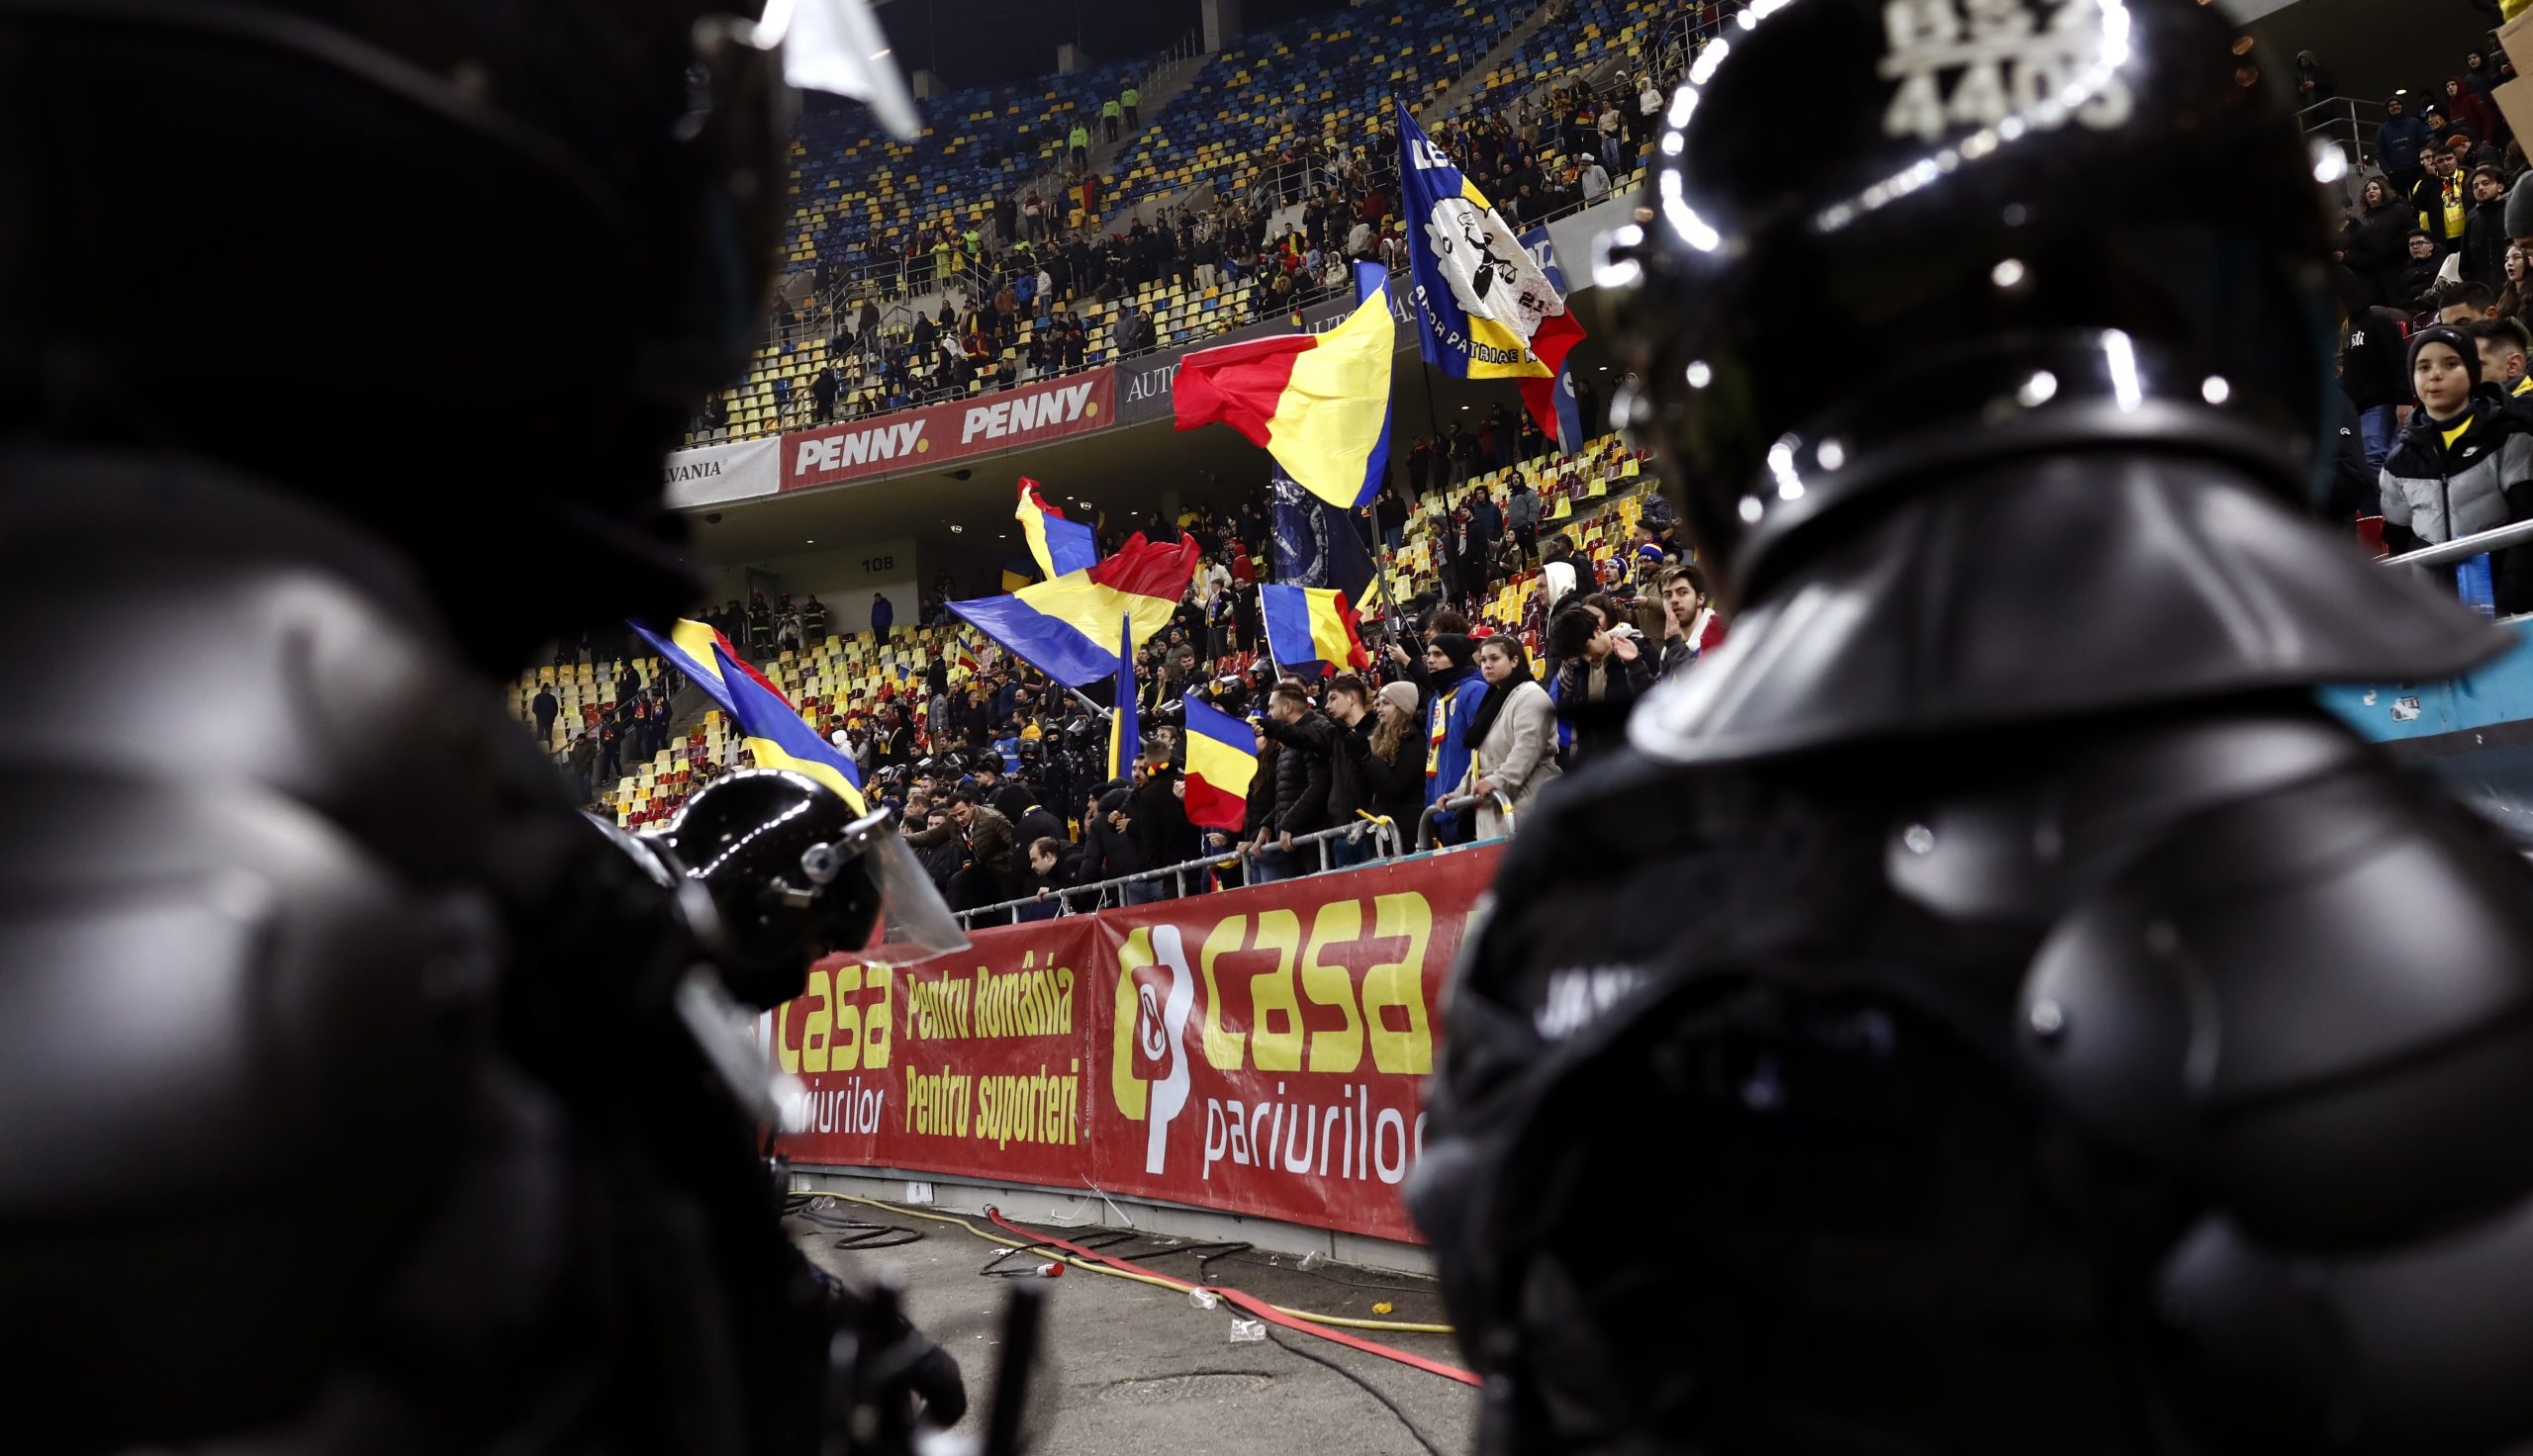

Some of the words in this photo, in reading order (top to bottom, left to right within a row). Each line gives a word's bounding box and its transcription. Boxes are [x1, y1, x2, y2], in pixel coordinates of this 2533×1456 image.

[1411, 138, 1457, 170] LE
[1447, 330, 1519, 365] PATRIAE
[862, 556, 894, 573] 108
[905, 970, 970, 1040] Pentru
[974, 950, 1075, 1039] România
[779, 1076, 885, 1134] riurilor
[905, 1065, 972, 1138] Pentru
[976, 1058, 1079, 1150] suporteri
